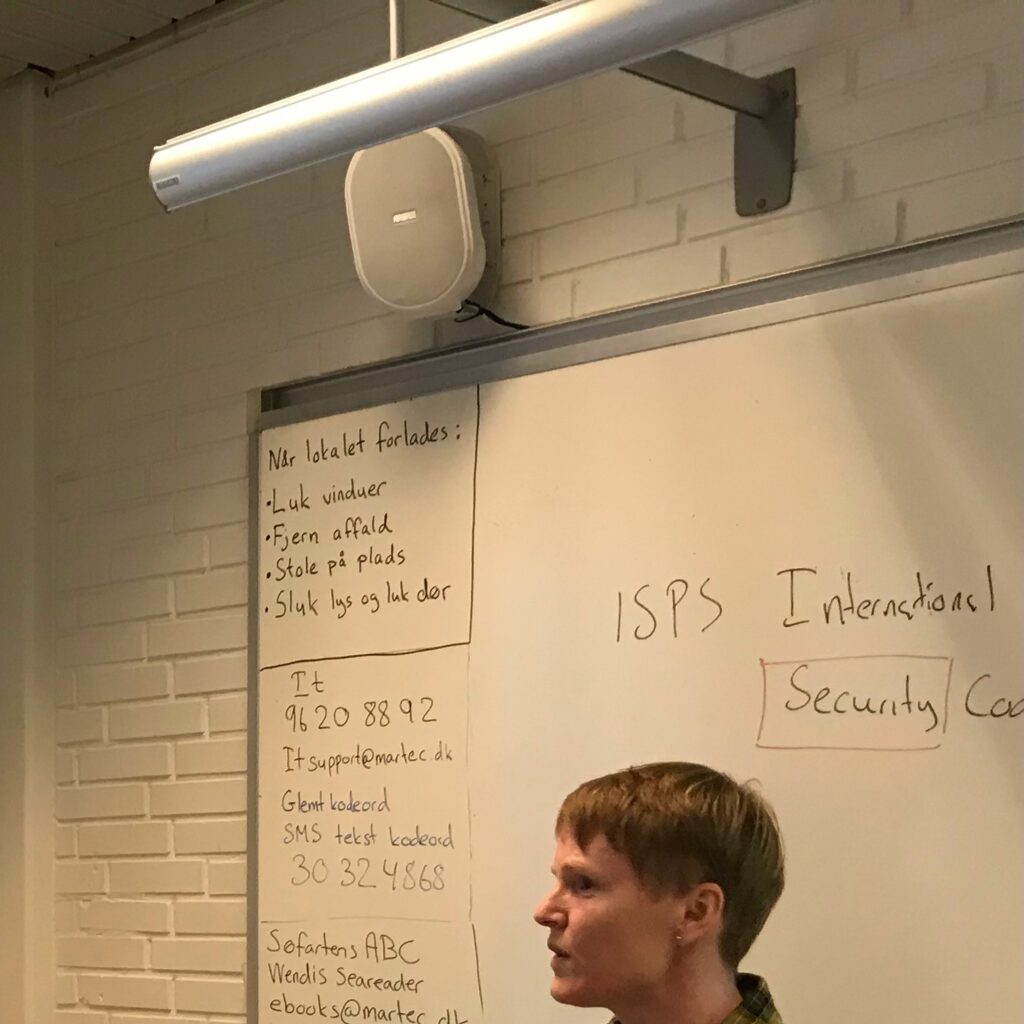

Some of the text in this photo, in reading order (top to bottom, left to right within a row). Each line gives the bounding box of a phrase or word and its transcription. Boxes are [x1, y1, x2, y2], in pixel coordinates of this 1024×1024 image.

[269, 447, 296, 471] Når
[306, 428, 365, 463] lokalet
[322, 478, 387, 505] vinduer
[273, 513, 393, 551] Fjern affald
[275, 544, 406, 581] Stole på plads
[275, 577, 452, 619] Sluk lys og luk dør
[616, 577, 722, 643] ISPS
[290, 671, 324, 698] It
[785, 664, 938, 733] Security
[330, 787, 390, 813] kodeord
[284, 823, 454, 849] SMS tekst kodeord
[365, 931, 420, 964] ABC
[268, 962, 424, 994] Wendis Seareader
